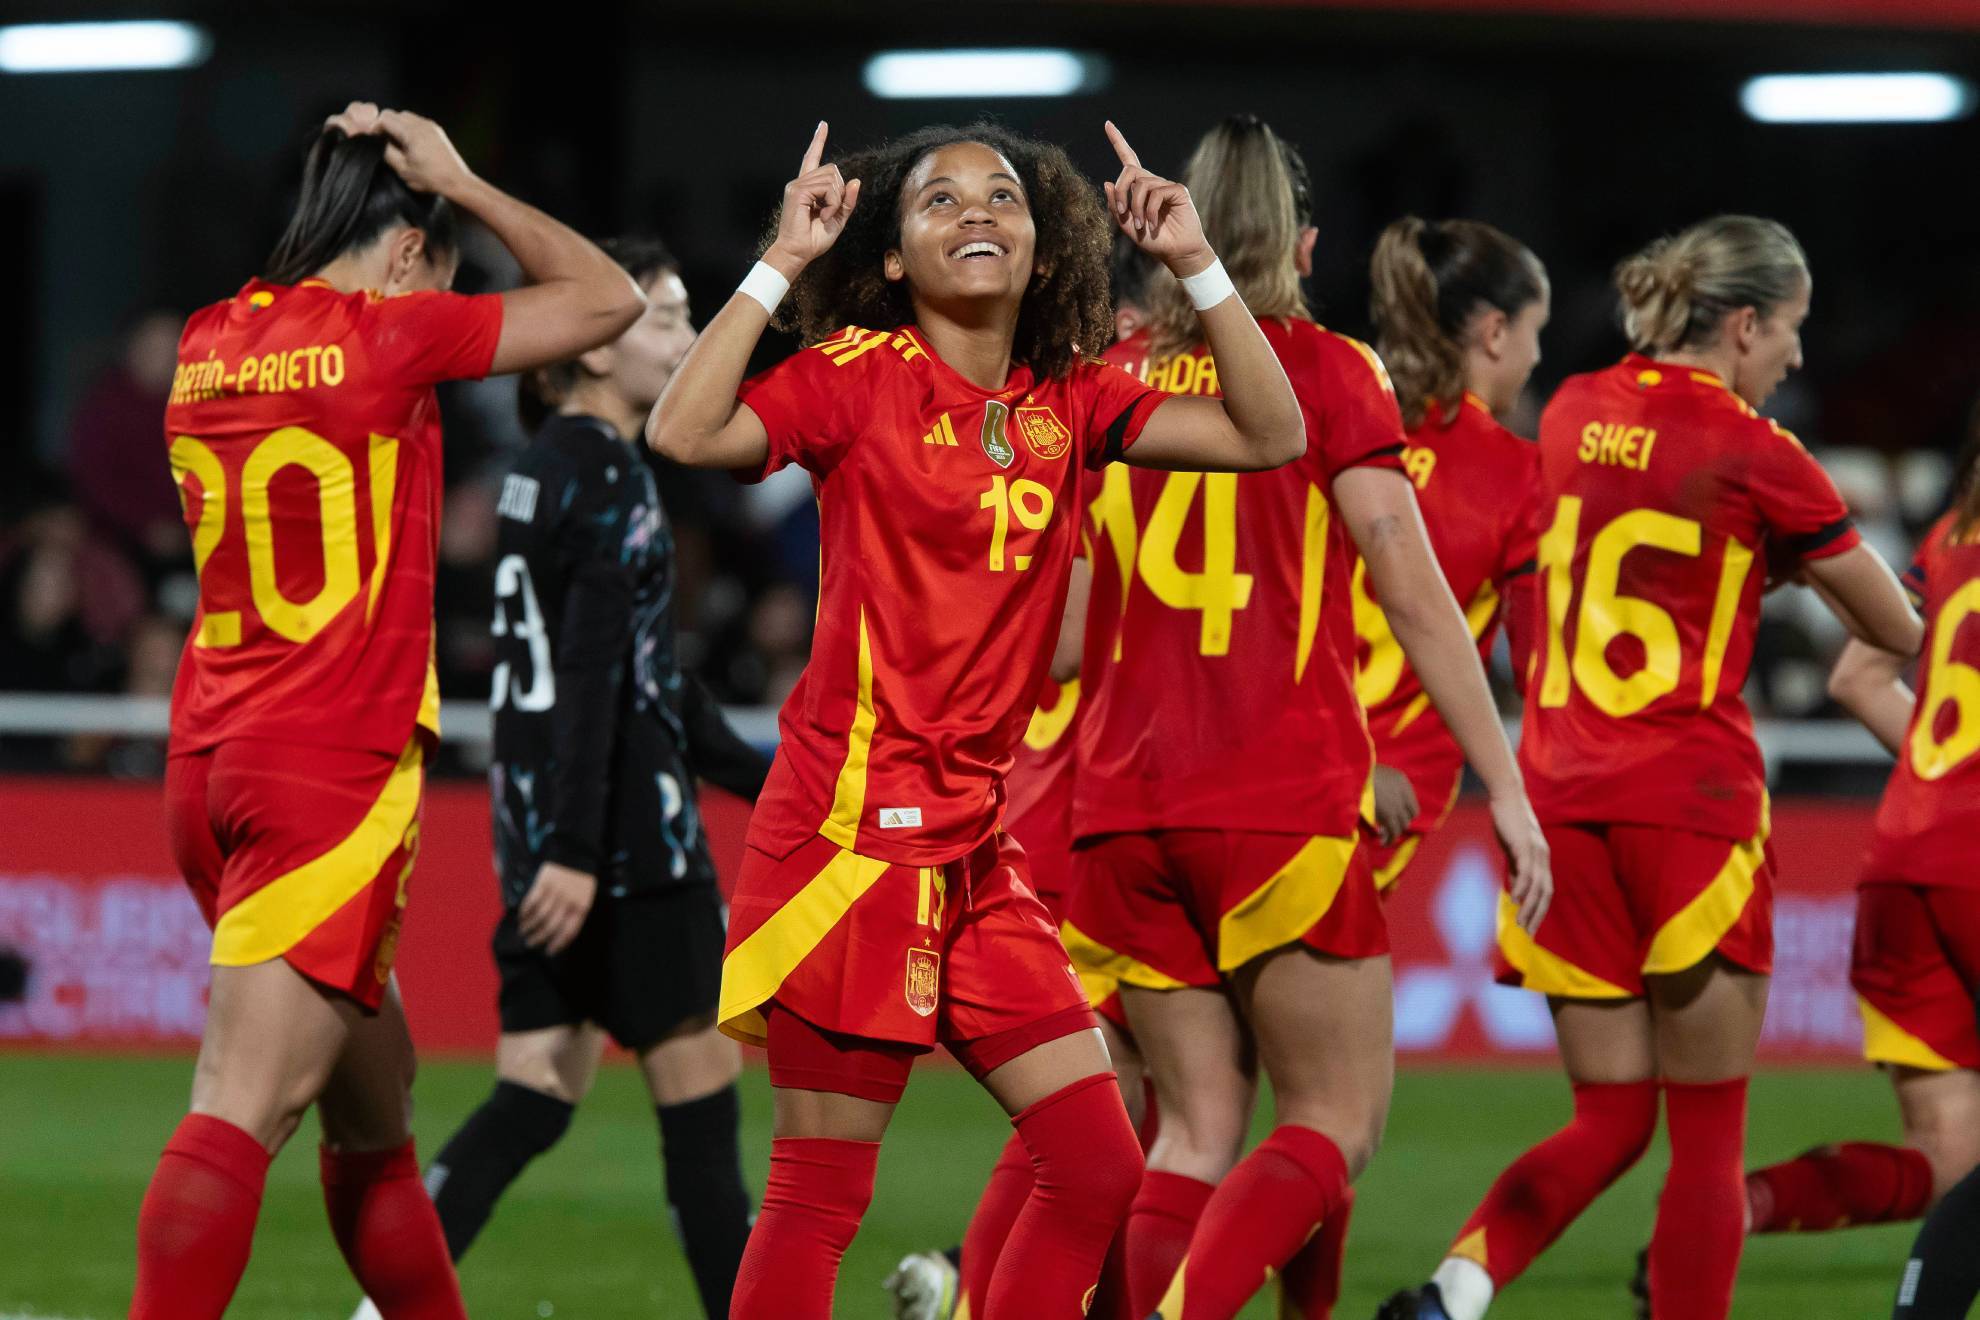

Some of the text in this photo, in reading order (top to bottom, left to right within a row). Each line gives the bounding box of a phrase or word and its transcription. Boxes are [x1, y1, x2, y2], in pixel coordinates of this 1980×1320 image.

[170, 425, 361, 648] 20
[980, 475, 1054, 571] 19
[1578, 421, 1657, 471] SHEI
[1088, 461, 1254, 661] 14
[1537, 495, 1701, 717] 16
[1911, 576, 1980, 781] 6
